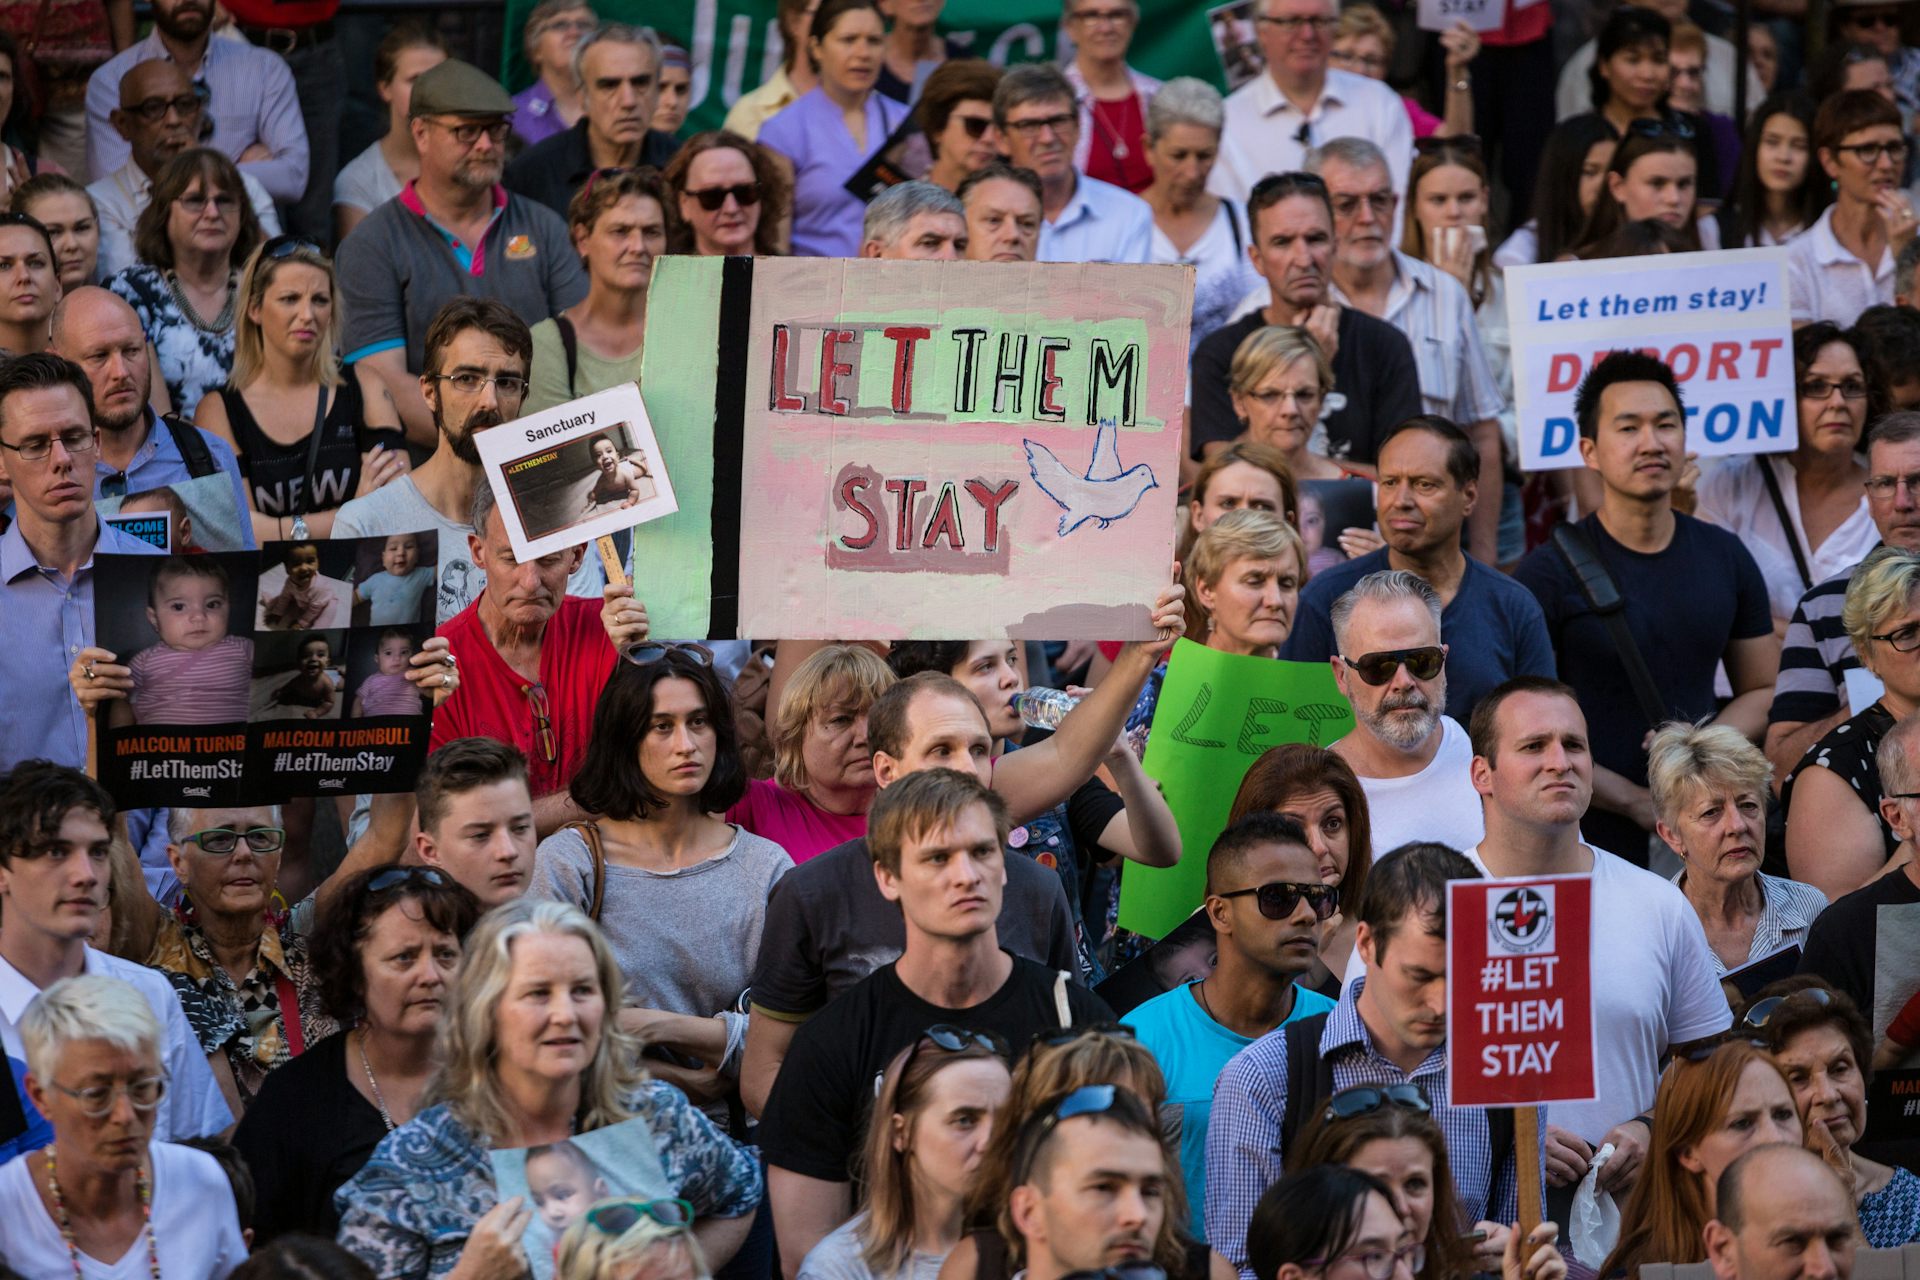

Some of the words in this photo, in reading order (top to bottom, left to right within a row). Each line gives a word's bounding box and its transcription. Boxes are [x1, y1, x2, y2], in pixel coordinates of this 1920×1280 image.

[1538, 297, 1589, 321] Let
[1600, 294, 1678, 317] them
[1688, 282, 1767, 311] stay!
[769, 323, 931, 416] LET
[951, 328, 1140, 427] THEM
[1546, 339, 1783, 393] DORT
[525, 410, 597, 443] Sanctuary
[255, 467, 351, 514] NEW
[840, 475, 1020, 552] STAY
[1170, 682, 1350, 755] LET
[116, 736, 191, 757] MALCOLM
[263, 731, 335, 748] MALCOLM
[338, 727, 411, 748] TURNBULL
[273, 751, 395, 773] #LetThemStay
[1480, 956, 1560, 992] #LET
[1475, 998, 1564, 1035] THEM
[1481, 1041, 1561, 1077] STAY
